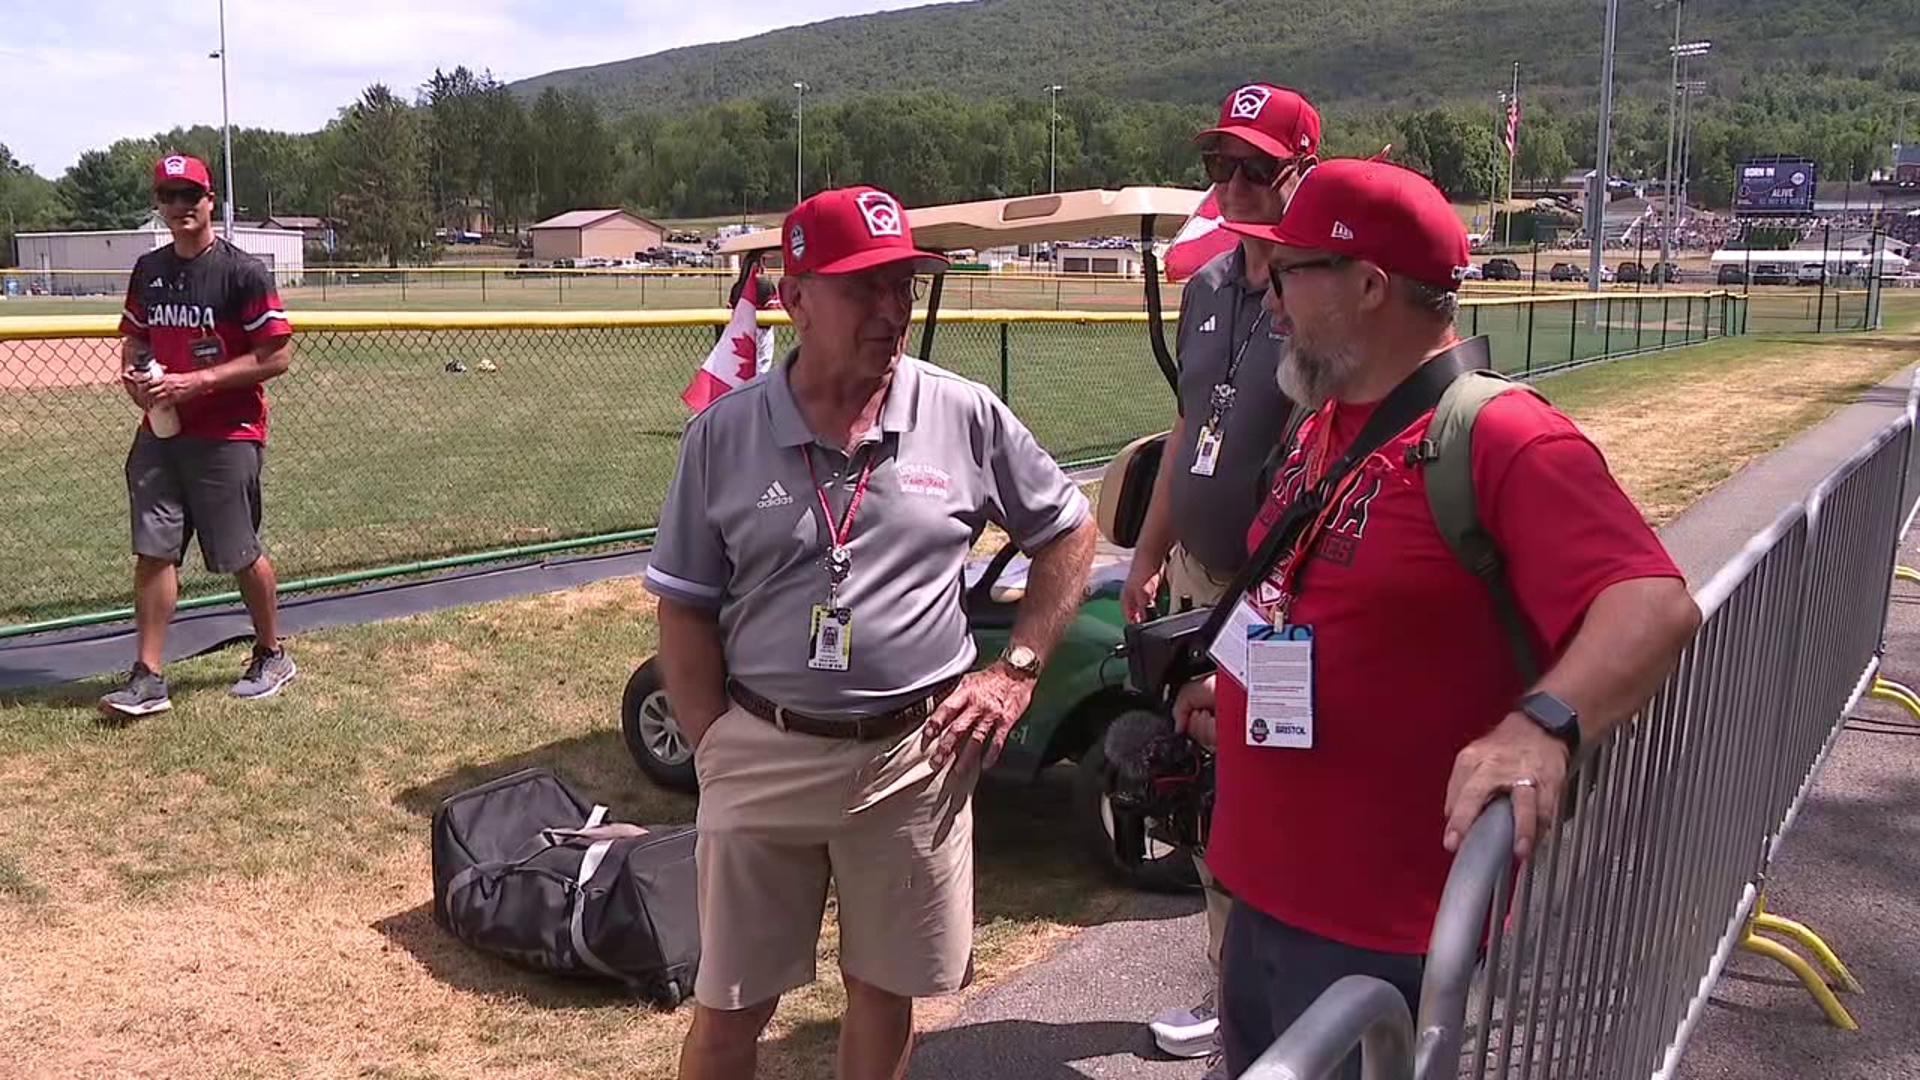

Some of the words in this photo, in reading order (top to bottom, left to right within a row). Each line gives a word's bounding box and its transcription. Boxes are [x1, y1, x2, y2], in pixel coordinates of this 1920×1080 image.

[1744, 167, 1764, 177] BORN
[1766, 167, 1775, 177] IN
[1771, 188, 1795, 198] ALIVE
[148, 304, 214, 329] CANADA
[757, 495, 794, 508] adidas
[1274, 725, 1307, 735] BRISTOL
